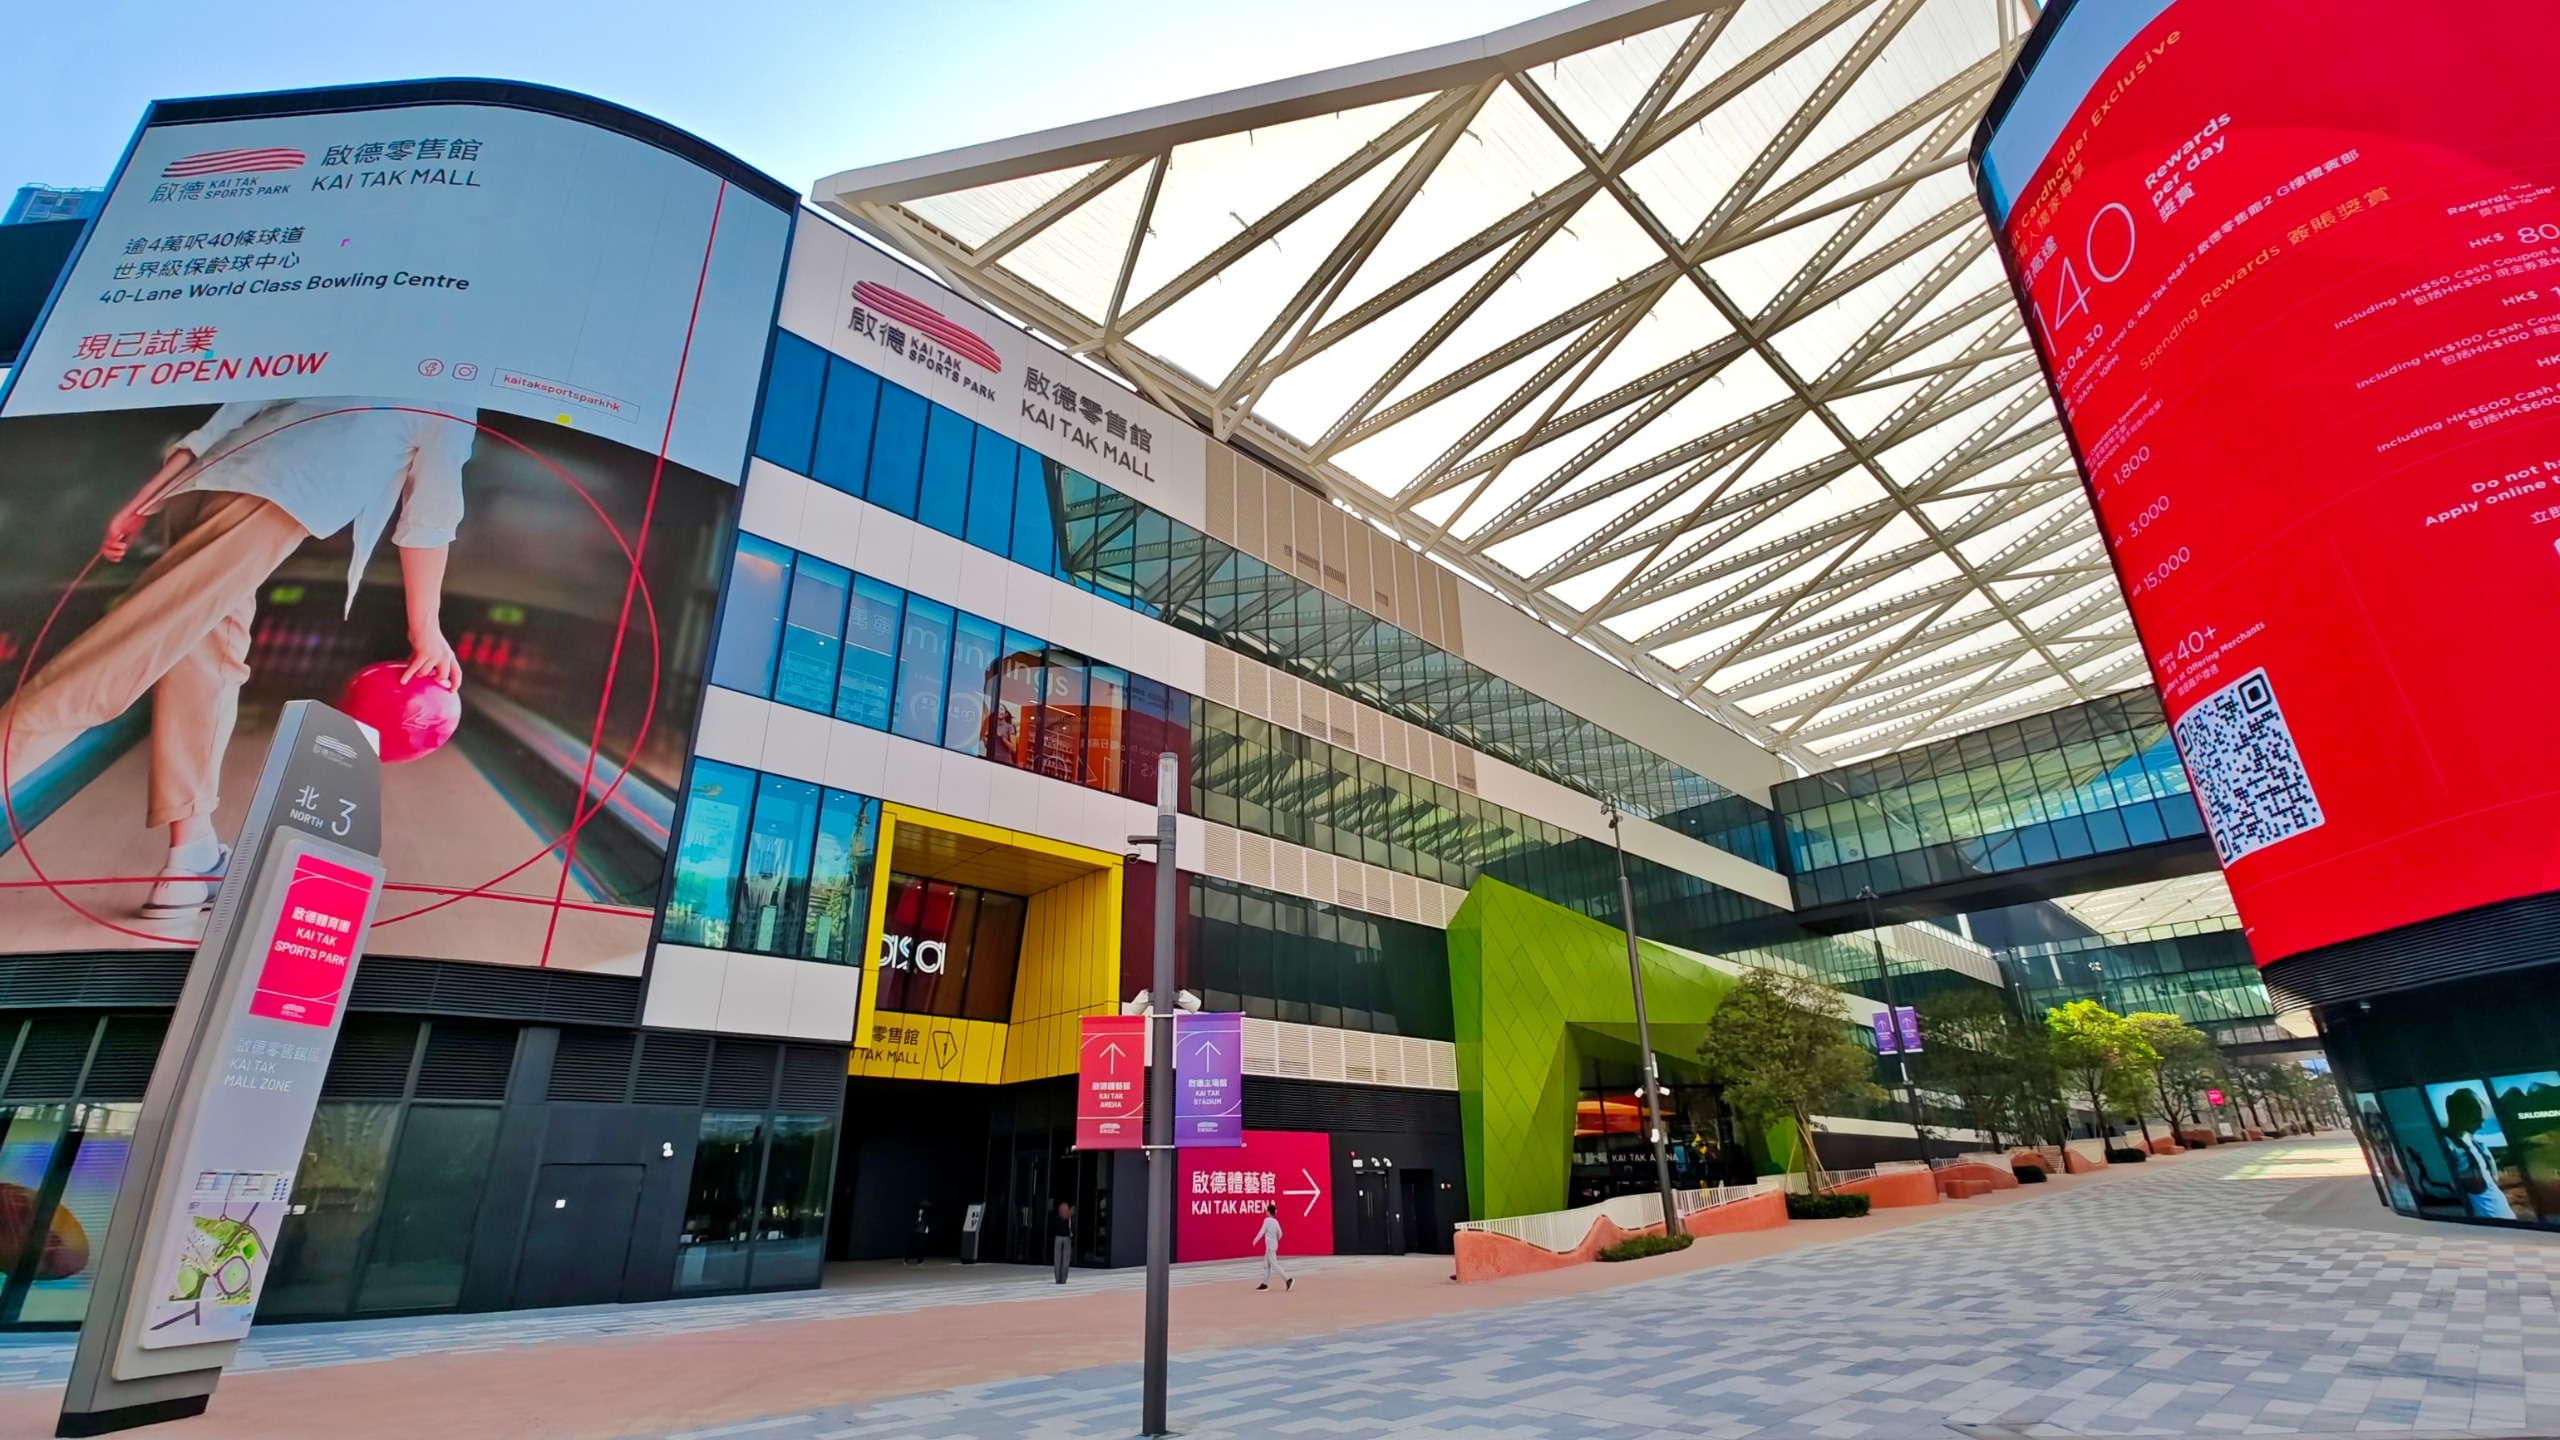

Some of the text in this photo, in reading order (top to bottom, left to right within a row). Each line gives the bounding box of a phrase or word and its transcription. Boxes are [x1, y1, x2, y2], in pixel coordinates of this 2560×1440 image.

[2021, 29, 2181, 228] Cardholder Exclusive
[321, 138, 483, 167] 啟德零售館
[2144, 113, 2231, 190] Rewards
[208, 177, 260, 189] KAI TAK
[311, 168, 481, 192] KAI TAK MALL
[2151, 134, 2226, 208] per day
[150, 181, 205, 203] 啟德
[204, 184, 292, 200] SPORTS PARK
[2469, 232, 2505, 249] HK$
[99, 271, 470, 304] 40-Lane World Class Bowling Centre
[2137, 300, 2151, 318] Kai
[2151, 284, 2168, 302] Tak
[2167, 261, 2188, 285] Mall
[2188, 252, 2197, 264] 2
[2334, 296, 2397, 330] Including
[2400, 275, 2450, 300] HK$50
[2454, 263, 2490, 279] Cash
[2493, 249, 2548, 267] Coupon
[2502, 290, 2538, 307] HK$
[2139, 307, 2198, 370] Spending
[2200, 245, 2281, 308] Rewards
[73, 325, 218, 360] 現已試業
[847, 306, 906, 357] 啟德
[57, 351, 329, 391] SOFT OPEN NOW
[910, 336, 962, 371] KAI TAK
[2356, 357, 2421, 390] Including
[2423, 334, 2483, 360] HK$100
[2486, 322, 2524, 338] Cash
[503, 374, 621, 412] kaitaksportsparkhk
[908, 350, 996, 402] SPORTS PARK
[1023, 366, 1152, 454] 啟德零售館
[2376, 386, 2553, 453] Including HK$600 Cash
[1021, 399, 1155, 483] KAI TAK MALL
[2113, 445, 2150, 485] 1,800
[2471, 480, 2500, 493] Do
[2504, 465, 2540, 483] not
[2128, 495, 2169, 538] 3,000
[2425, 501, 2479, 527] Apply
[2485, 481, 2547, 504] online
[2143, 546, 2190, 591] 15,000
[2177, 626, 2216, 660] 40+
[2186, 651, 2220, 675] Offering
[2220, 621, 2266, 653] Merchants
[295, 785, 320, 811] 北
[290, 808, 324, 828] NORTH
[331, 798, 357, 836] 3
[274, 940, 347, 967] SPORTS PARK
[296, 927, 337, 947] KAI TAK
[230, 1058, 277, 1073] KAI TAK
[887, 1050, 920, 1064] MALL
[224, 1074, 293, 1092] MALL ZONE
[1098, 1092, 1124, 1100] KAI TAK
[1612, 1154, 1626, 1162] KAI
[1629, 1153, 1646, 1162] TAK
[1192, 1170, 1276, 1194] 啟德體藝館
[1192, 1200, 1211, 1215] KAI
[1214, 1200, 1237, 1215] TAK
